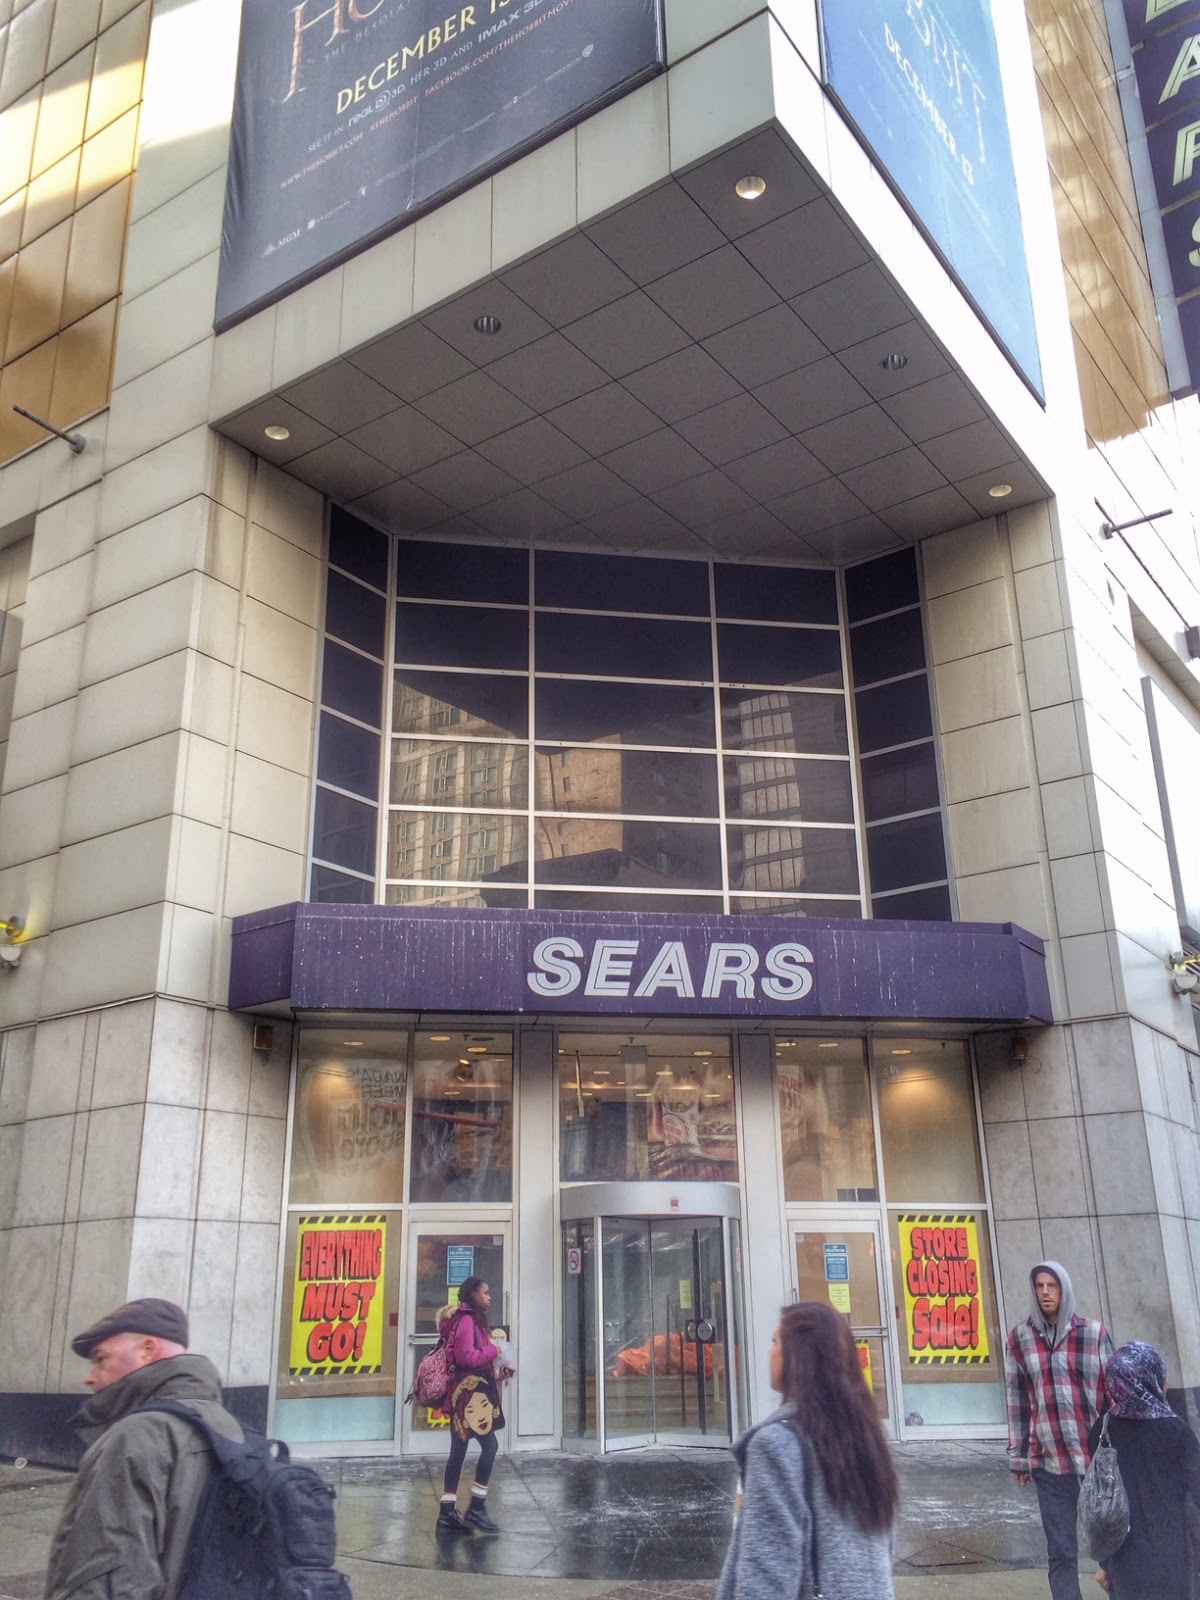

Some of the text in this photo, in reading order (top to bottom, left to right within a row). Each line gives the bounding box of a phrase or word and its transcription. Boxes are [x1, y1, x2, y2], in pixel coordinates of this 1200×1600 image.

[308, 138, 322, 153] SEE
[323, 131, 333, 143] IT
[334, 125, 345, 137] IN
[410, 66, 430, 86] HFR
[433, 56, 447, 71] 3D
[451, 41, 473, 61] AND
[478, 10, 520, 44] IMAX
[336, 5, 477, 115] DECEMBER
[884, 22, 959, 162] DECEMBER
[280, 132, 364, 189] WWW.THEHOBBIT.COM
[369, 95, 418, 132] #THEHOBBIT
[526, 936, 814, 1001] SEARS
[299, 1228, 382, 1281] EVERYTHING
[911, 1226, 969, 1260] STORE
[300, 1281, 377, 1323] MUST
[907, 1259, 979, 1297] CLOSING
[306, 1321, 368, 1363] GO!
[912, 1297, 979, 1350] Sale!
